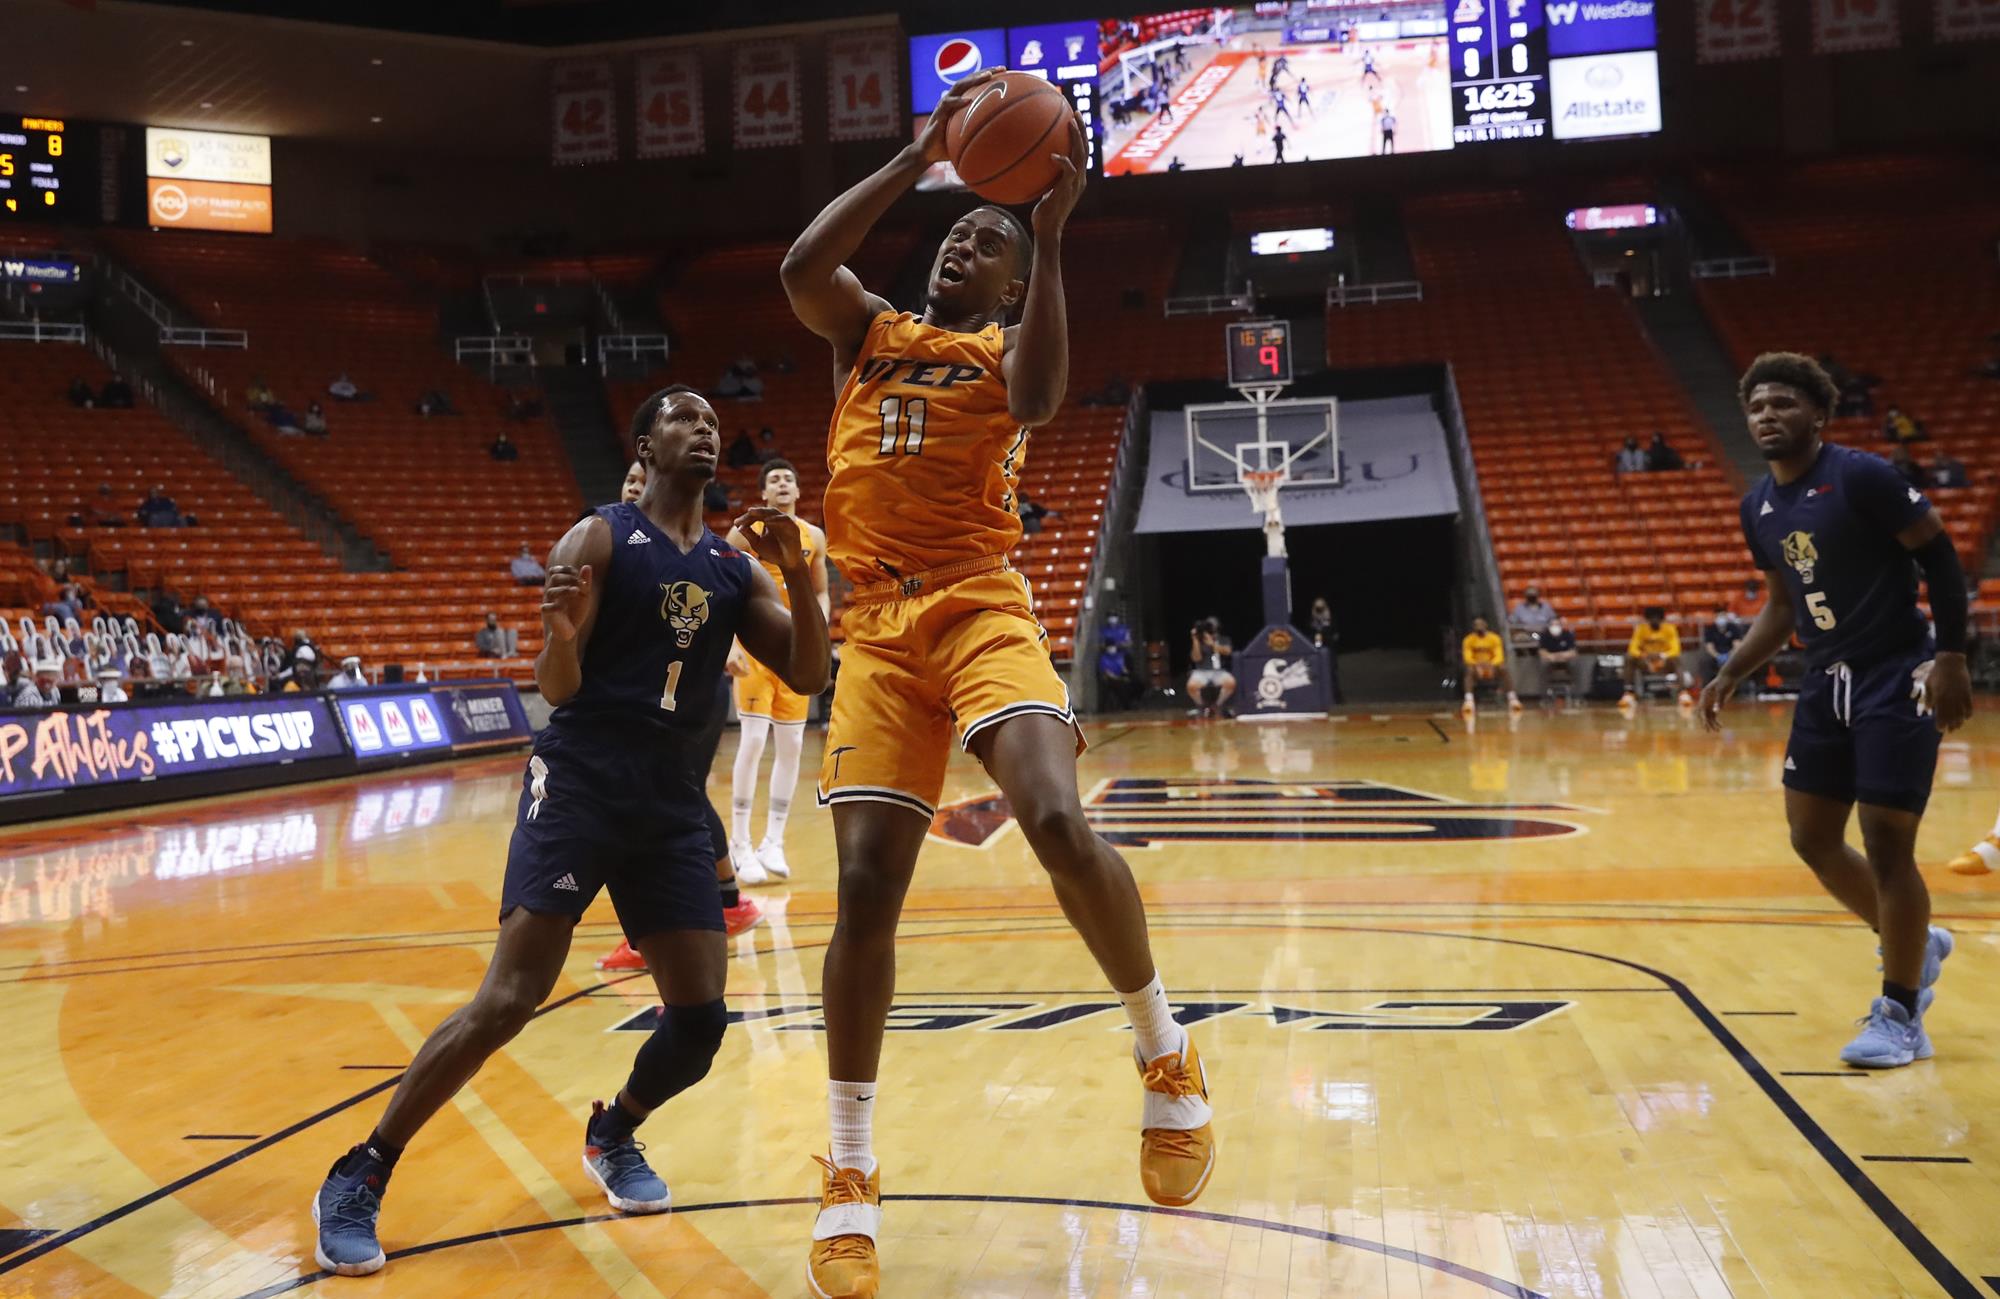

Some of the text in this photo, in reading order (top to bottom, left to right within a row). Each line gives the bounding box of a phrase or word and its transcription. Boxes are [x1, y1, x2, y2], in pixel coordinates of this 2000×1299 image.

[1581, 1, 1654, 21] WestStar
[744, 81, 790, 118] 44
[843, 74, 881, 111] 14
[1464, 82, 1535, 111] 16:25
[1563, 98, 1646, 120] Allstate
[562, 98, 606, 136] 42
[48, 135, 62, 156] 8
[1259, 346, 1278, 375] 9
[878, 395, 928, 455] 11
[1805, 591, 1837, 631] 5
[660, 660, 684, 711] 1
[0, 724, 29, 784] P
[151, 710, 315, 764] #PICKSUP
[553, 881, 580, 892] adidas
